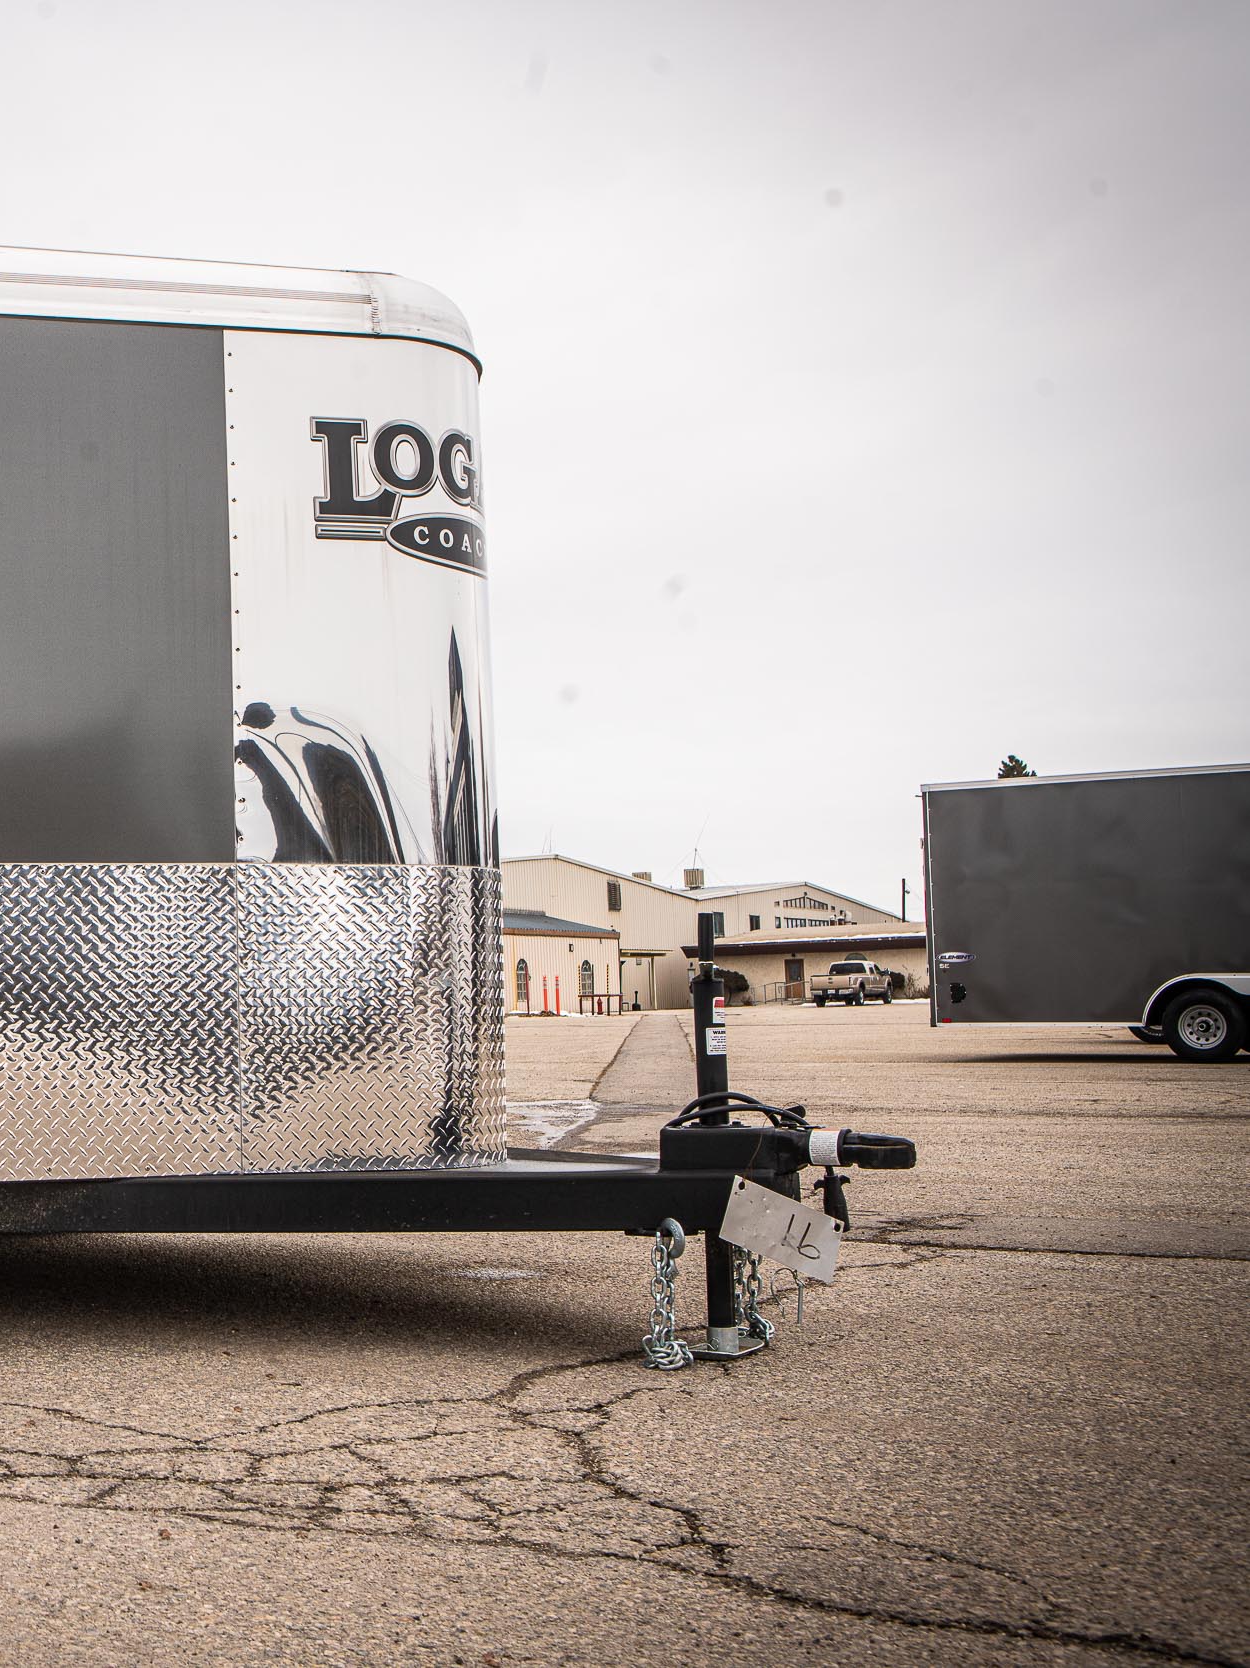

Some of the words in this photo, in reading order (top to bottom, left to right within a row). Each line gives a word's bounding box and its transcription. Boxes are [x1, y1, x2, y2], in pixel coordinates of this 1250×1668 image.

[310, 416, 483, 522] LOG
[413, 526, 486, 558] COAC
[781, 1213, 821, 1260] 16
